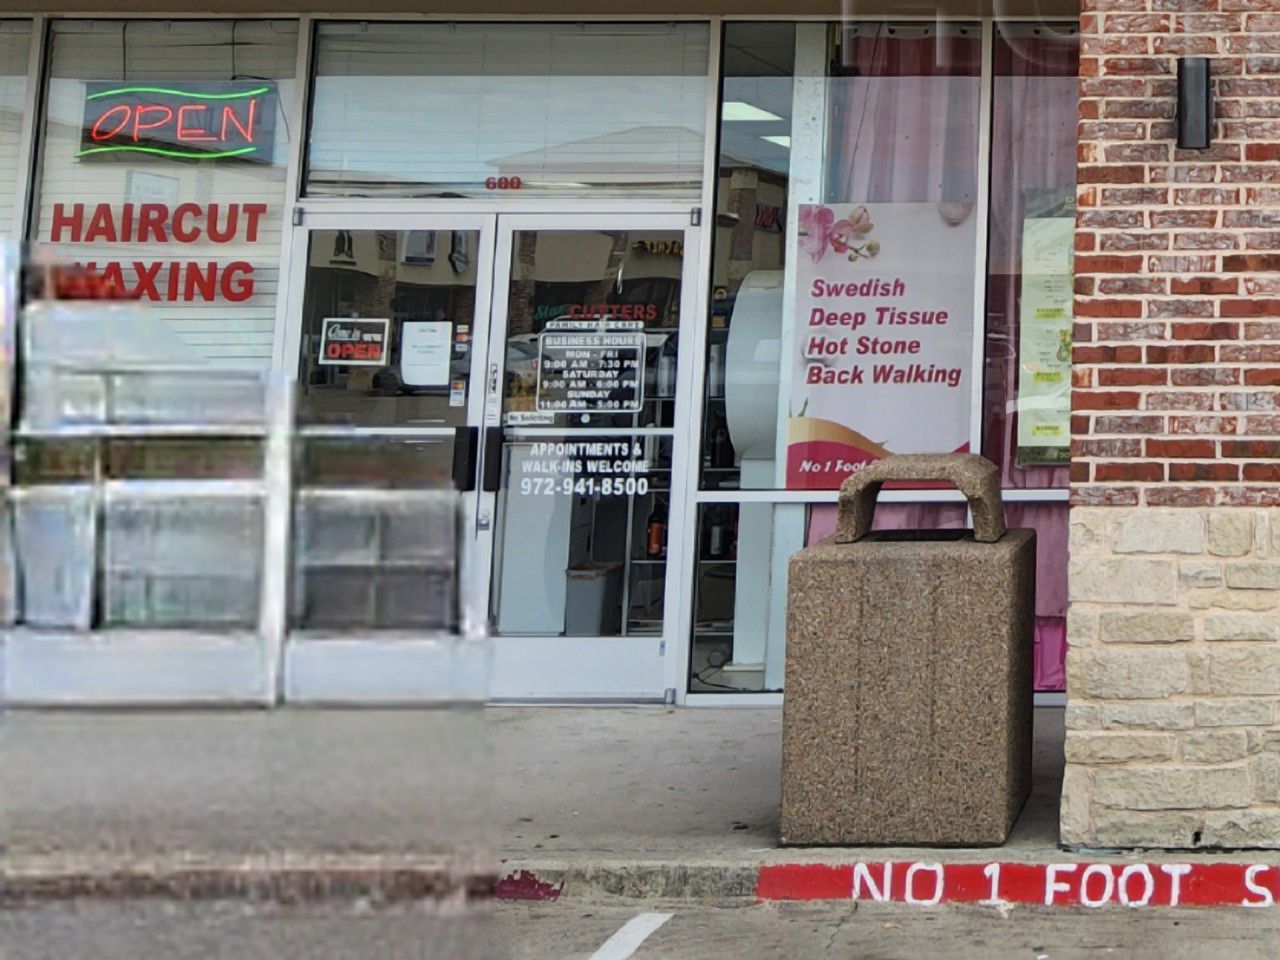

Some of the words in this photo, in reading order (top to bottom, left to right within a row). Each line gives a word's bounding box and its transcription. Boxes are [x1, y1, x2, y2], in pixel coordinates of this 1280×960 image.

[91, 99, 256, 142] OPEN
[50, 203, 268, 243] HAIRCUT
[54, 261, 255, 302] AXING
[811, 278, 906, 298] Swedish
[569, 304, 657, 320] CUTTERS
[808, 307, 866, 330] Deep
[875, 307, 949, 326] Tissue
[545, 336, 600, 346] BUSINESS
[604, 336, 641, 346] HOURS
[808, 337, 848, 355] Hot
[856, 336, 921, 355] Stone
[327, 343, 382, 359] OPEN
[565, 350, 590, 359] MON
[600, 350, 618, 359] FRI
[571, 359, 588, 369] AM
[624, 359, 639, 369] PM
[562, 370, 619, 379] SATURDAY
[807, 365, 864, 384] Back
[872, 364, 962, 387] Walking
[569, 380, 587, 389] AM
[623, 380, 639, 389] PM
[567, 390, 611, 399] SUNDAY
[569, 400, 587, 409] AM
[623, 400, 638, 409] PM
[530, 442, 629, 457] APPOINTMENTS
[632, 442, 642, 456] &
[522, 460, 583, 473] WALK-INS
[586, 460, 650, 473] WELCOME
[799, 460, 821, 472] No
[824, 461, 832, 472] 1
[835, 460, 866, 472] Foot
[520, 478, 649, 496] 972-941-8500
[853, 863, 945, 906] NO
[979, 863, 1001, 905] 1
[1044, 863, 1192, 907] FOOT
